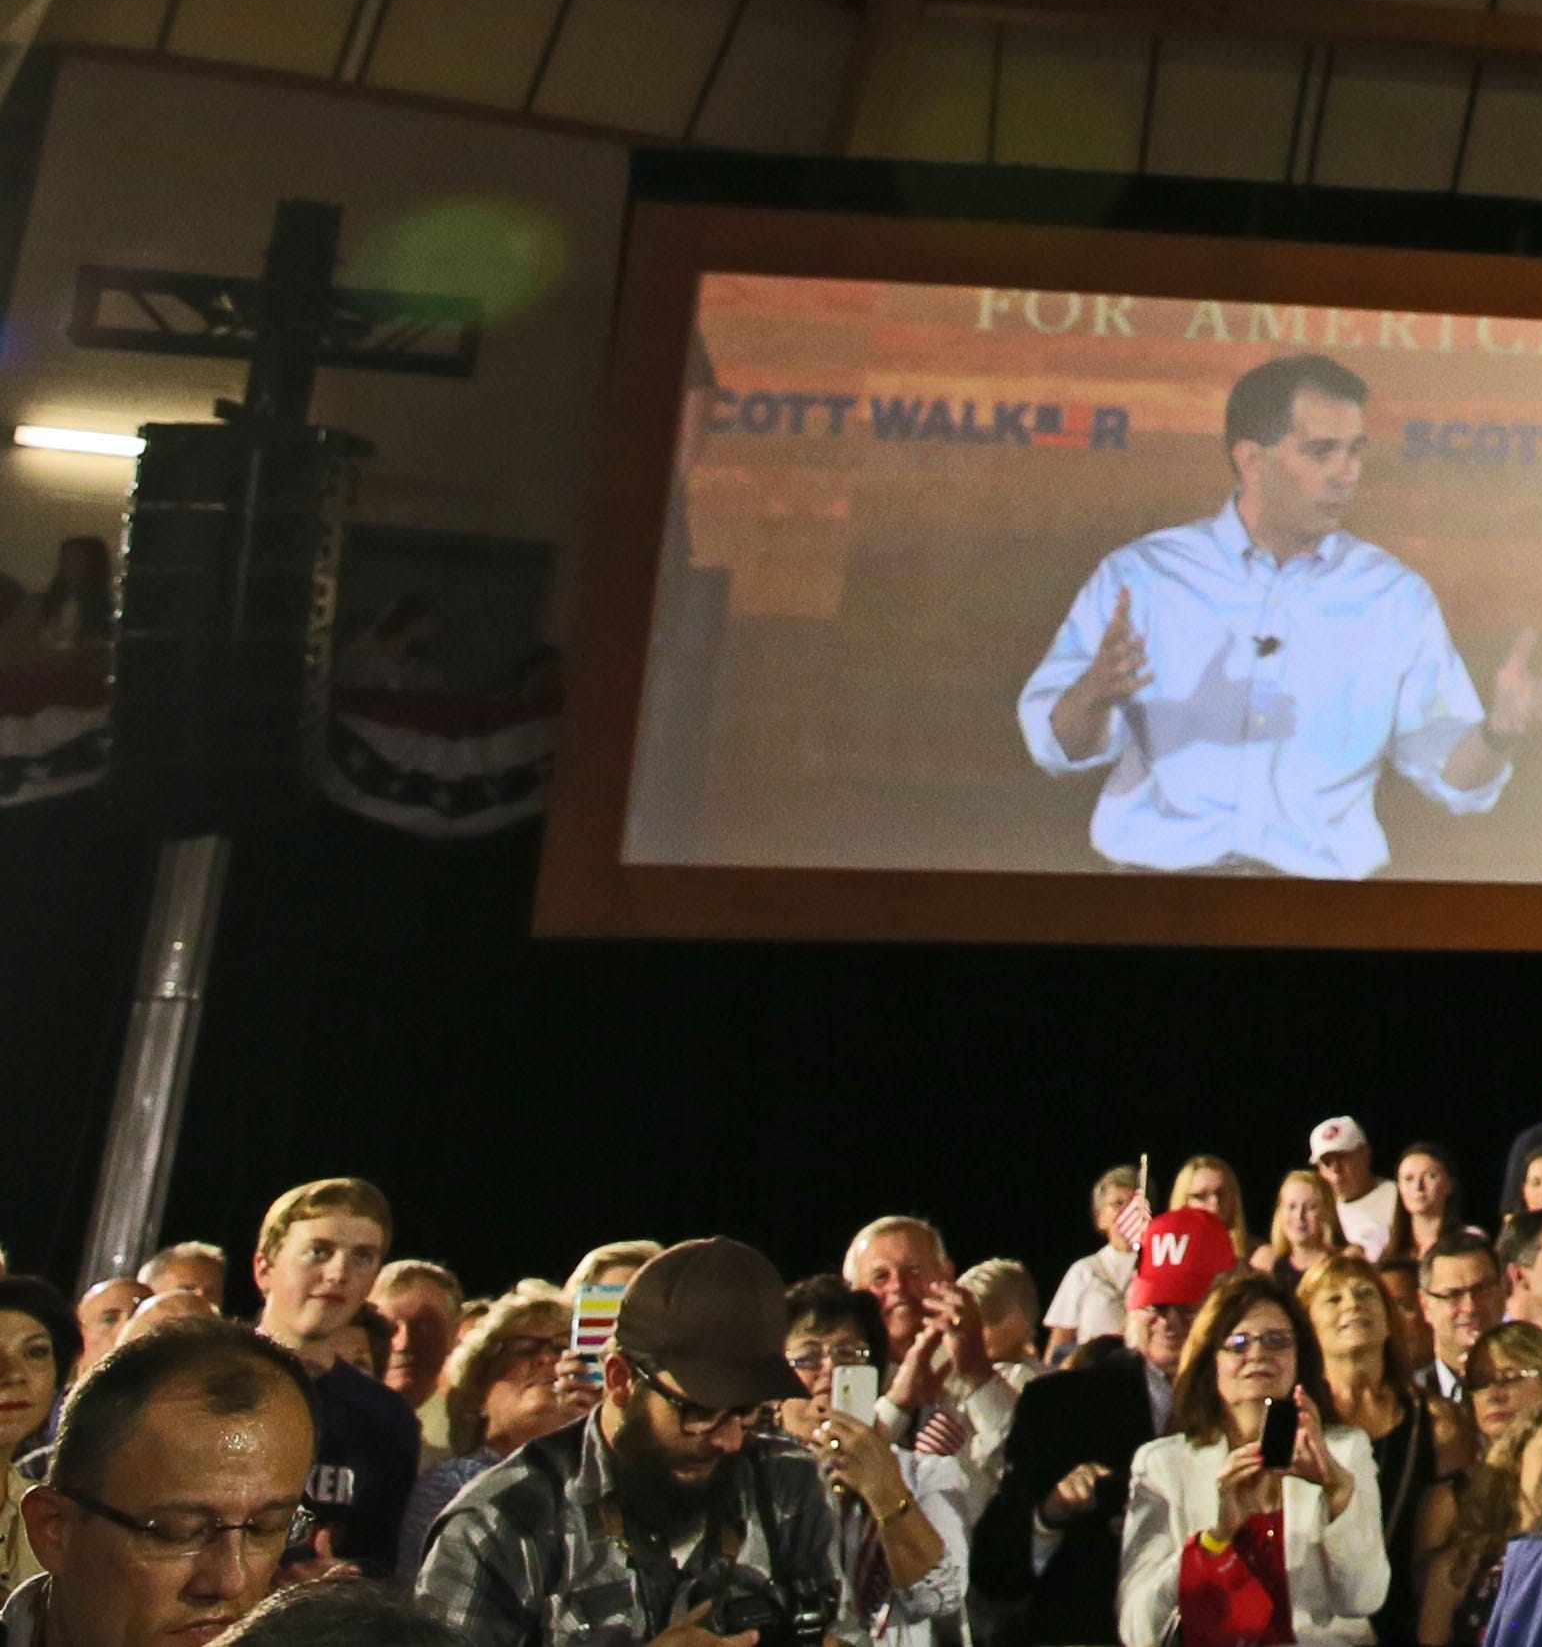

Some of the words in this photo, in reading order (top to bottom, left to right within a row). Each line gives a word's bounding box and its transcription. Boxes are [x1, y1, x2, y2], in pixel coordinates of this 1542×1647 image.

[974, 288, 1137, 338] FOR
[704, 387, 858, 437] COTT
[1151, 1232, 1191, 1267] W
